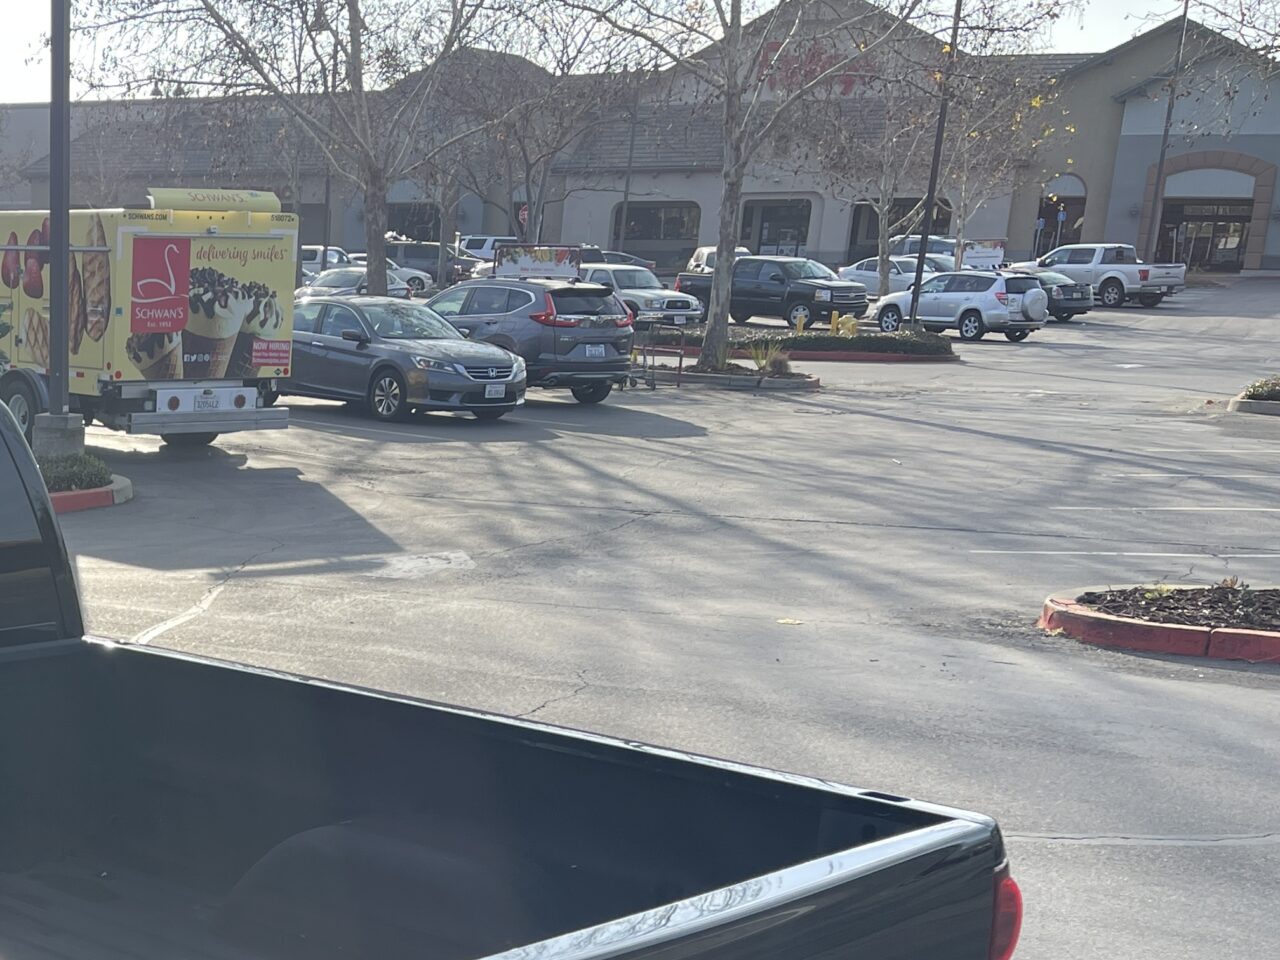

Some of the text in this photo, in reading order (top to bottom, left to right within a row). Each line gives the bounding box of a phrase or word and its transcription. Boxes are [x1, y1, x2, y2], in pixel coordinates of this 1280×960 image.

[196, 244, 251, 267] delivering
[135, 307, 184, 319] SCHWAN'S
[253, 341, 268, 351] NOW
